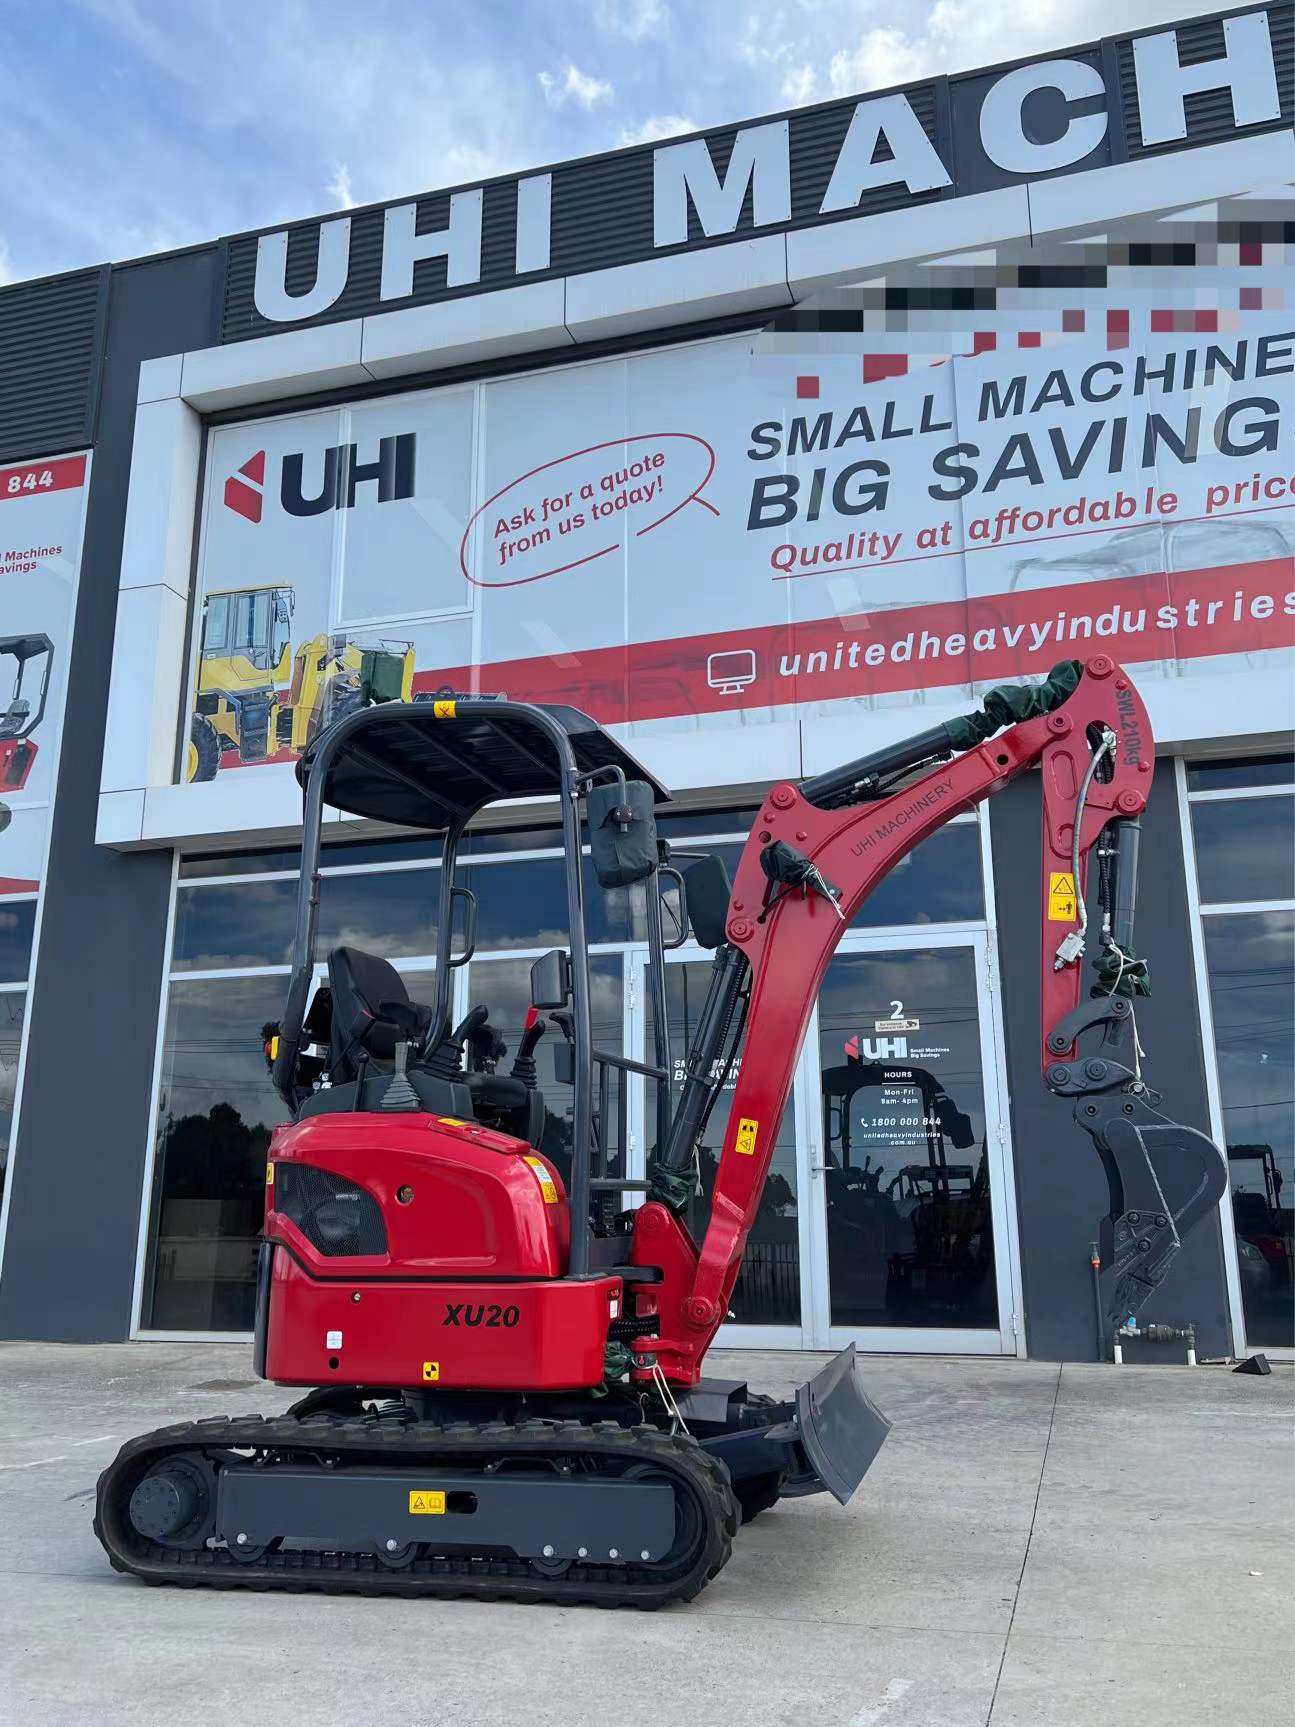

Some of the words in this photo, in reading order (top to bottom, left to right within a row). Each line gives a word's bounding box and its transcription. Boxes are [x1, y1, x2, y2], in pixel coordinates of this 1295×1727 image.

[254, 173, 552, 322] UHI
[653, 11, 1281, 247] MACH
[747, 394, 953, 461] SMALL
[978, 331, 1295, 422] MACHINE
[8, 470, 54, 493] 844
[281, 432, 417, 517] UHI
[494, 507, 536, 538] Ask
[542, 491, 573, 521] for
[580, 483, 594, 500] a
[600, 452, 665, 492] quote
[747, 459, 891, 531] BIG
[5, 545, 63, 561] Machines
[499, 527, 551, 565] from
[558, 512, 585, 535] us
[592, 475, 663, 520] today!
[770, 531, 903, 573] Quality
[916, 521, 953, 549] at
[968, 487, 1178, 543] affordable
[1206, 473, 1295, 514] pric
[850, 835, 877, 857] UHI
[876, 779, 954, 840] MACHINERY
[890, 1000, 905, 1019] 2
[863, 1036, 908, 1060] UHI
[871, 1117, 897, 1127] 1800
[899, 1117, 919, 1126] 000
[922, 1116, 942, 1126] 844
[442, 1303, 521, 1328] XU20
